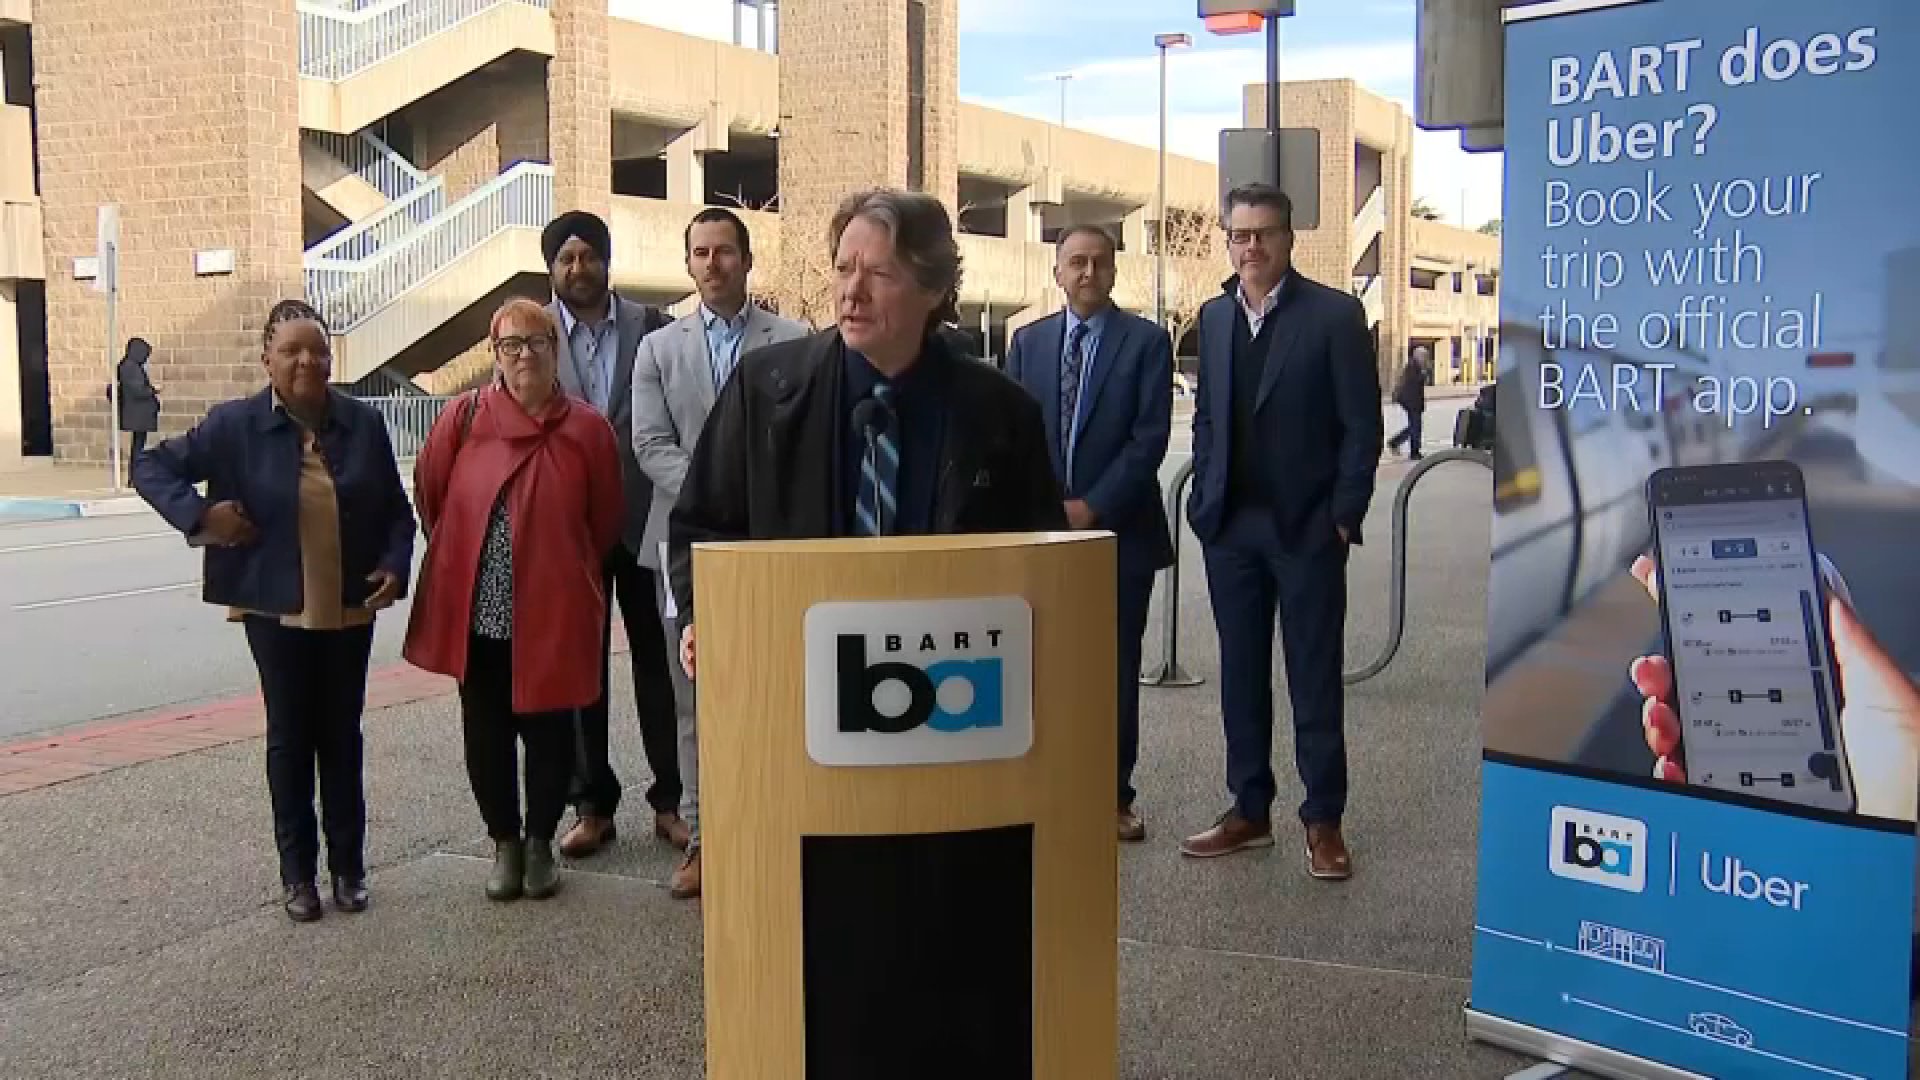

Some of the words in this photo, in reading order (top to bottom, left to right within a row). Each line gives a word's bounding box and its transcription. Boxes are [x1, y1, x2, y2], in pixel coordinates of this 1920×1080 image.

[1550, 38, 1703, 106] BART
[1719, 27, 1877, 86] does
[1546, 103, 1718, 167] Uber?
[1544, 170, 1673, 228] Book
[1692, 171, 1823, 240] your
[1541, 238, 1624, 300] trip
[1644, 229, 1764, 286] with
[1538, 298, 1620, 350] the
[1638, 292, 1824, 350] official
[1538, 362, 1676, 412] BART
[1692, 374, 1814, 429] app.
[884, 629, 1003, 652] BART
[1701, 850, 1810, 911] Uber
